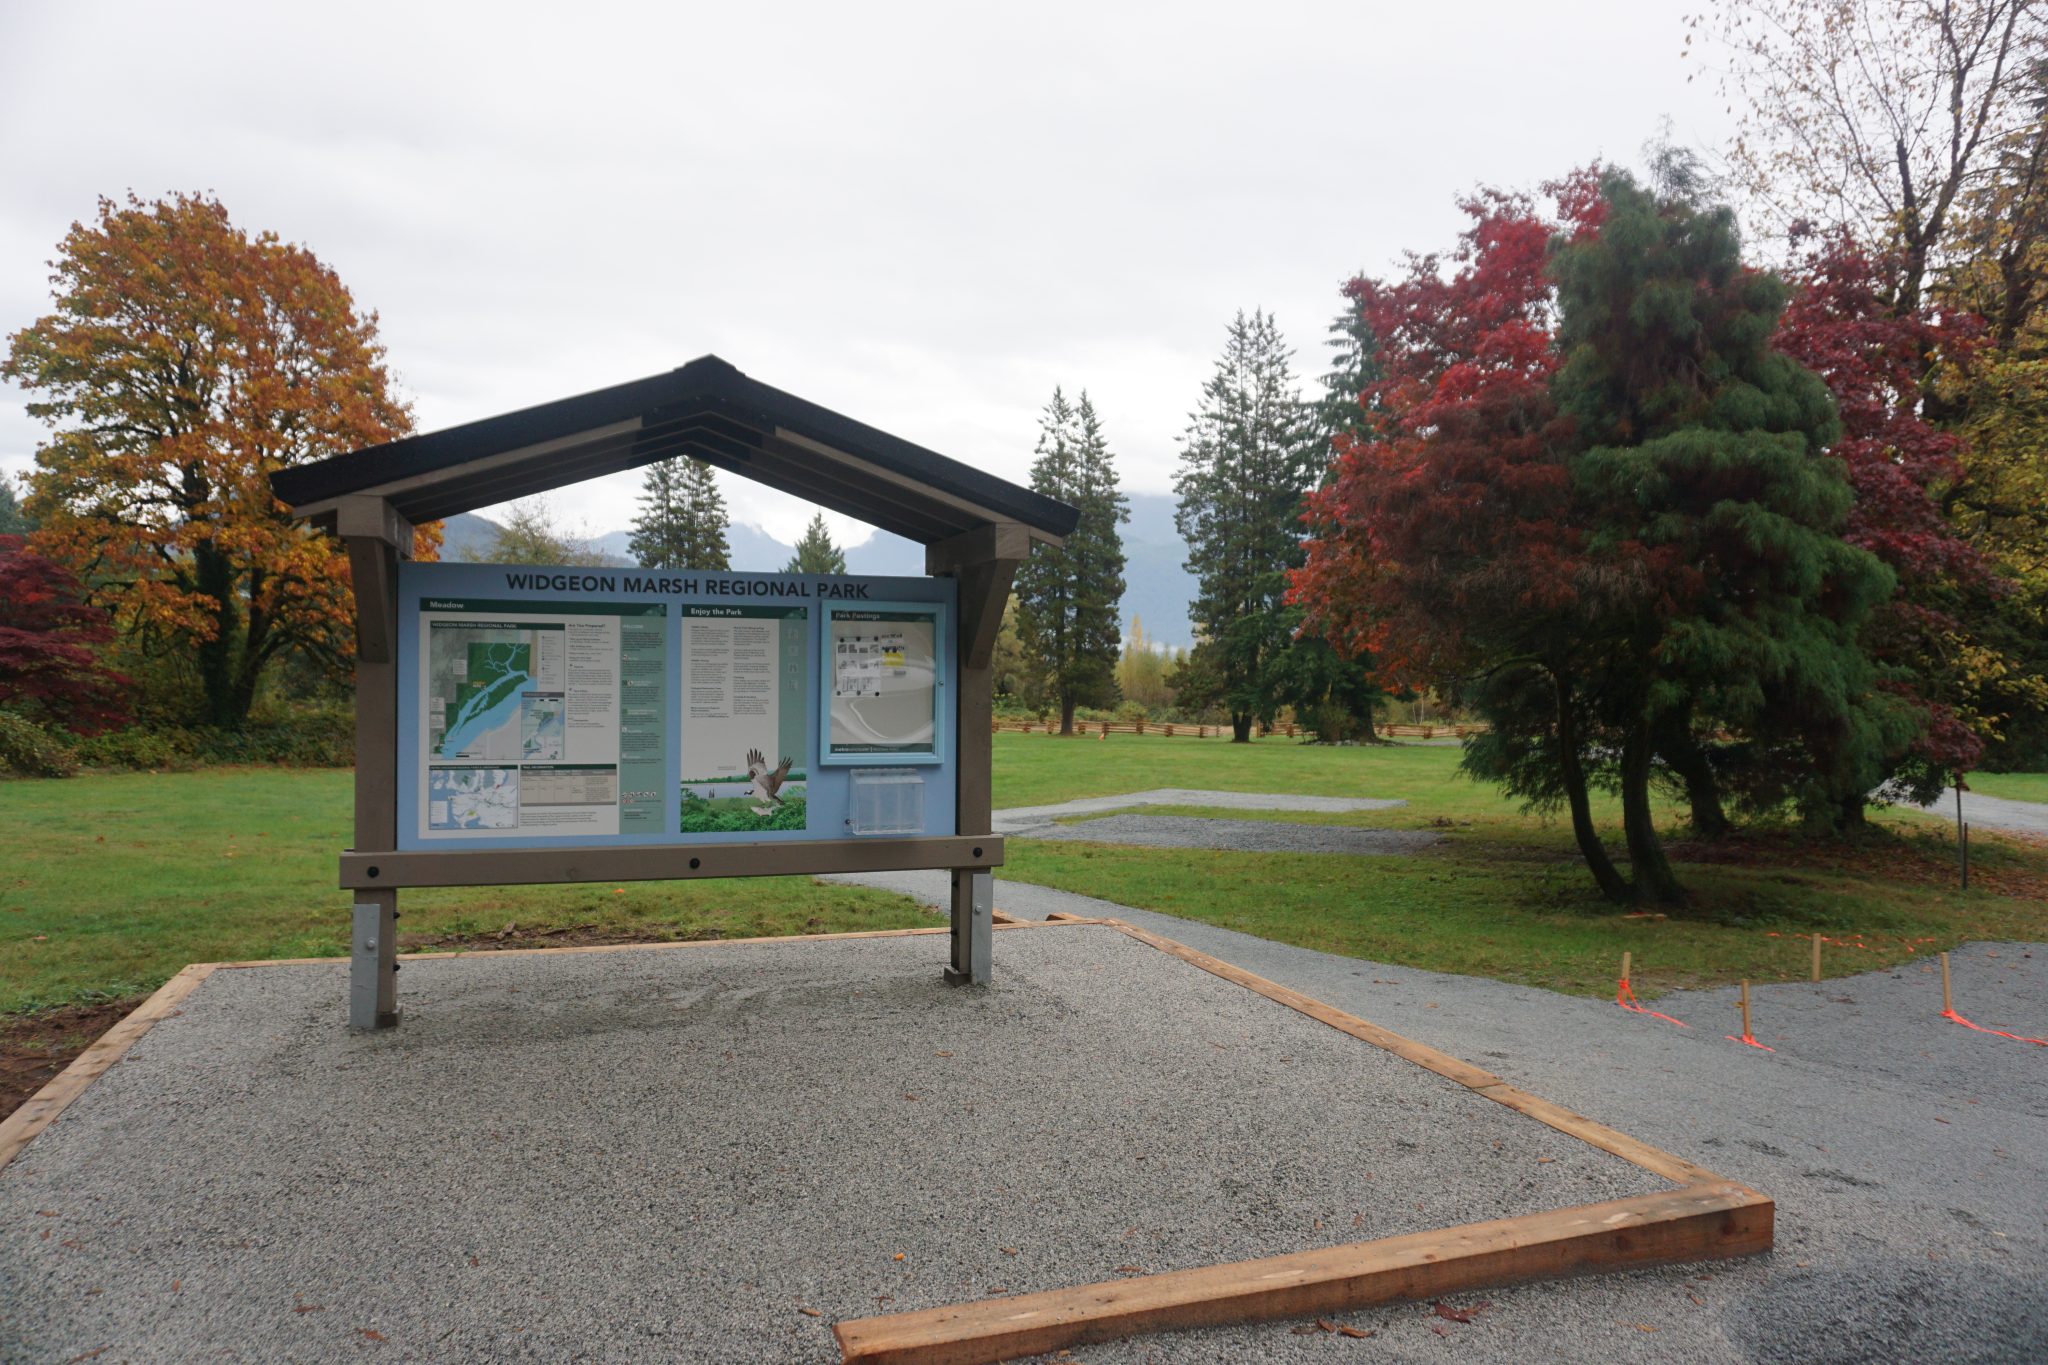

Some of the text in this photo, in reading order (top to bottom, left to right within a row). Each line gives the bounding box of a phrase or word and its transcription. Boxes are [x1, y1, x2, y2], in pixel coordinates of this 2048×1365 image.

[505, 573, 869, 599] WIDGEON MARSH REGIONAL PARK
[429, 601, 464, 609] Meadow
[690, 607, 711, 616] Enjoy
[725, 608, 742, 616] Park
